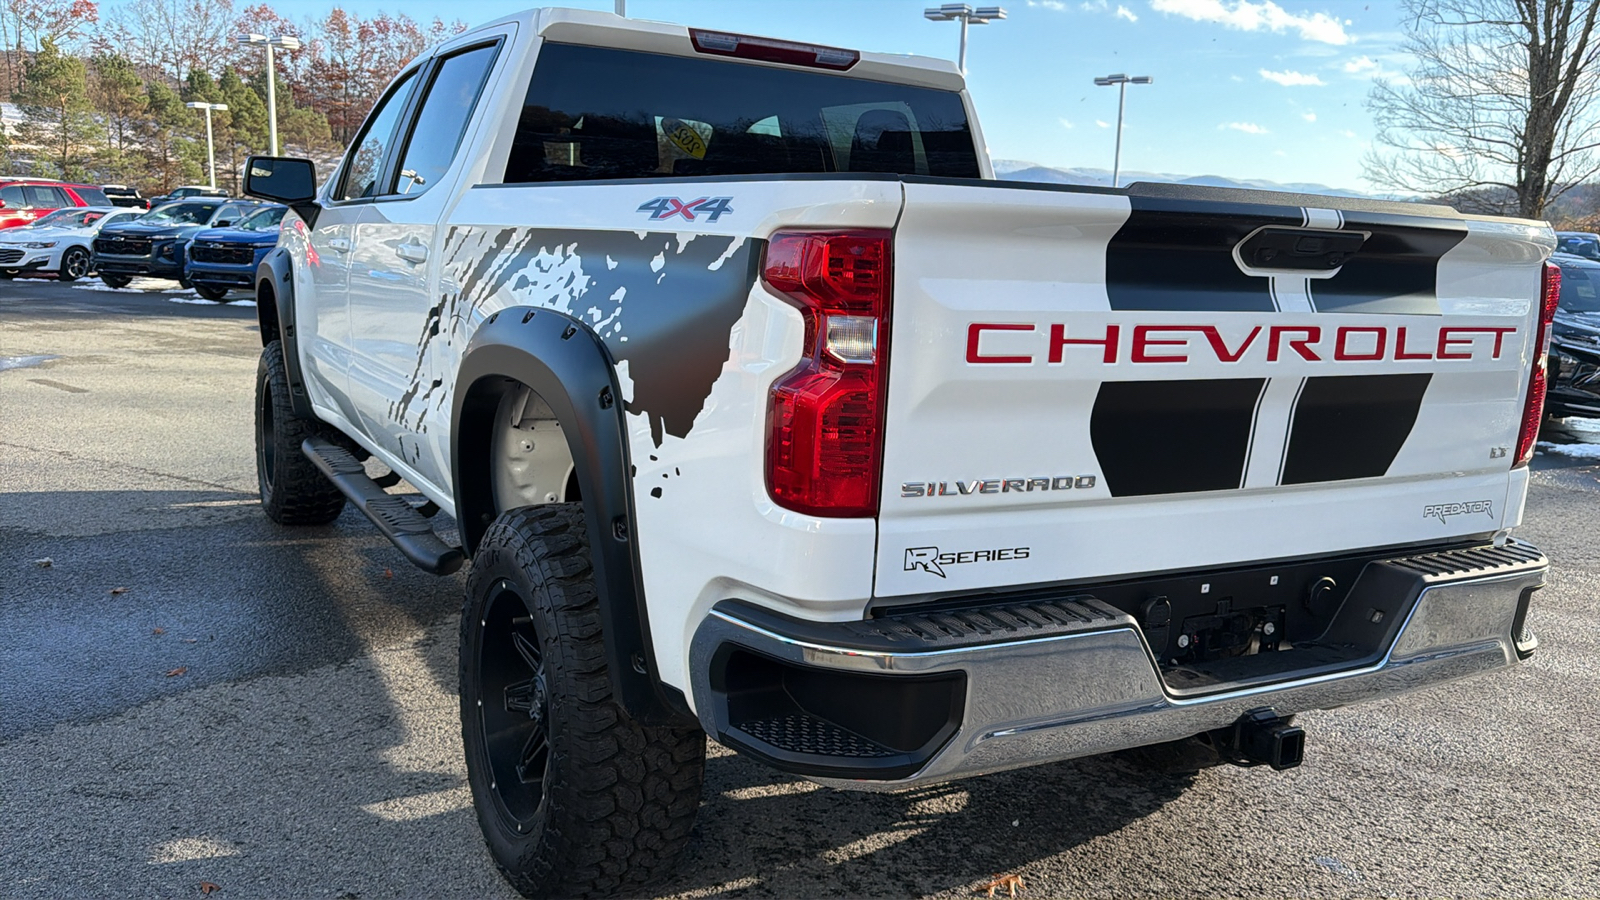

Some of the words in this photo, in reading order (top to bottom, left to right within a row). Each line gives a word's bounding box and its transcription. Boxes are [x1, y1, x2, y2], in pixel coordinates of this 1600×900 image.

[966, 323, 1517, 364] CHEVROLET
[901, 474, 1096, 497] SILVERADO
[1423, 500, 1494, 525] PREDATOR
